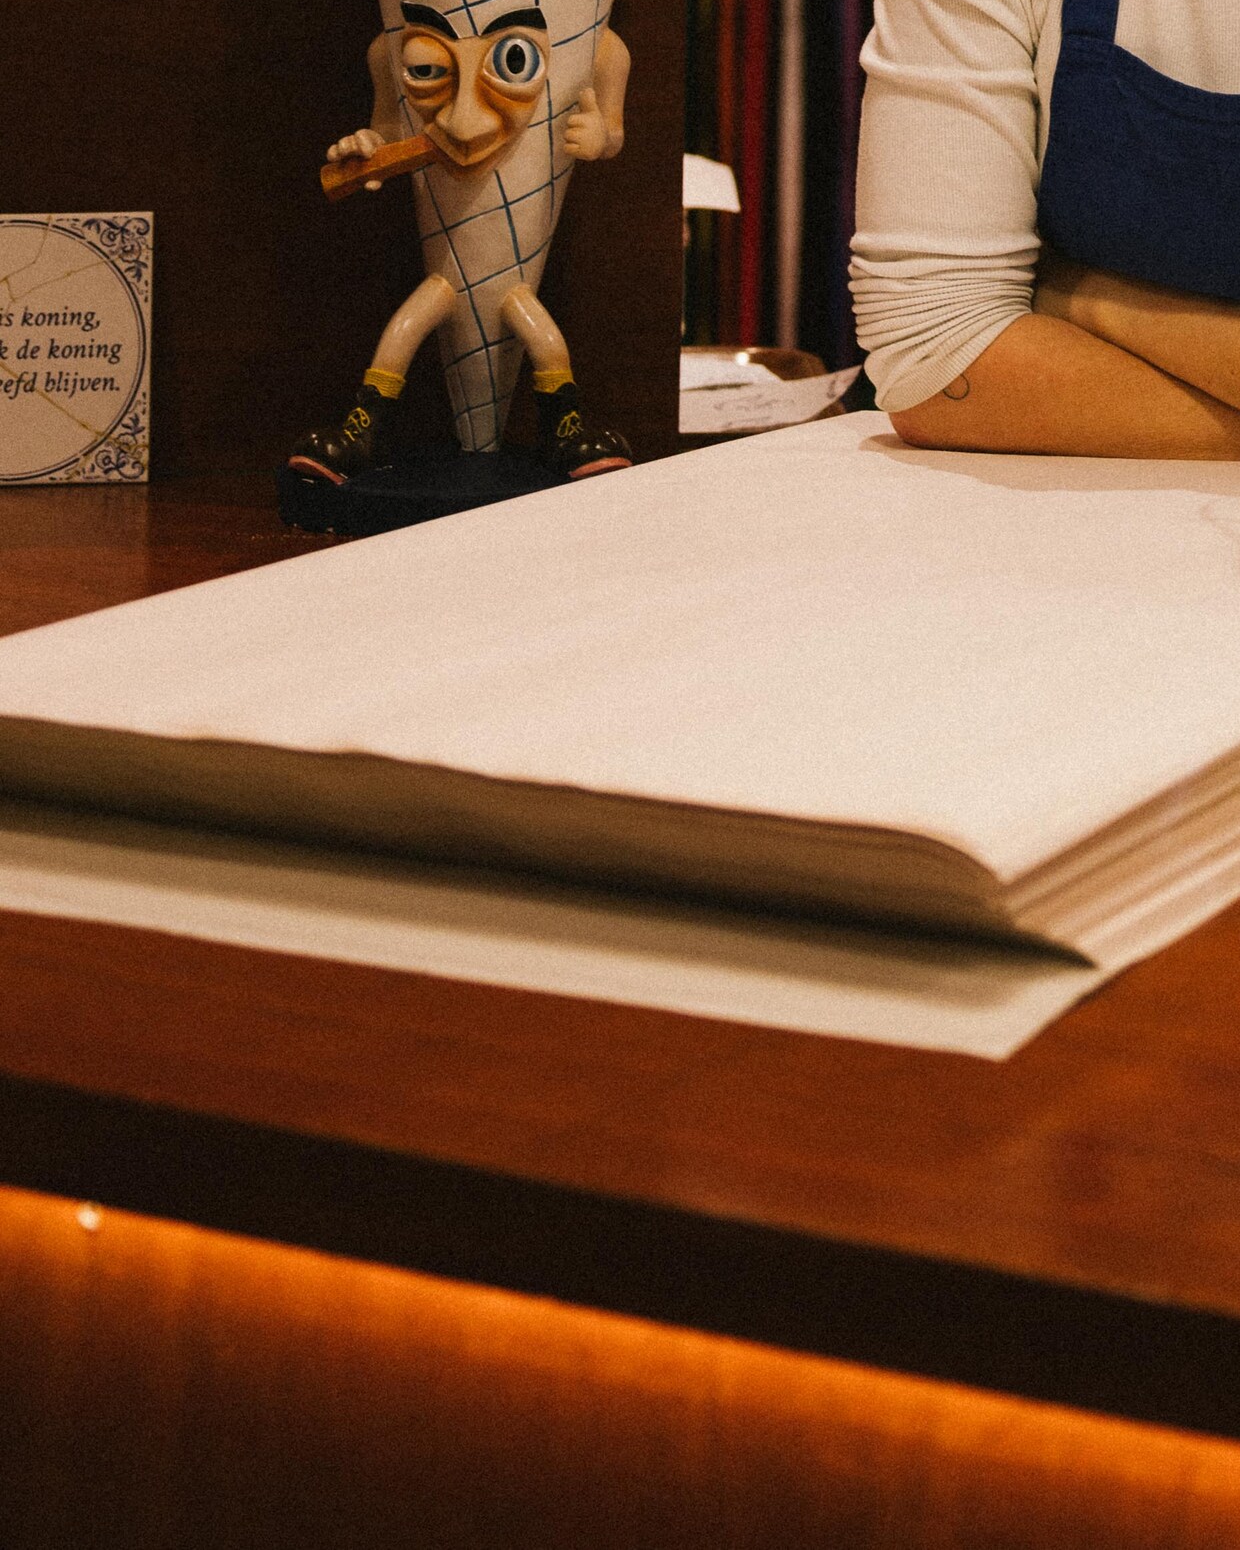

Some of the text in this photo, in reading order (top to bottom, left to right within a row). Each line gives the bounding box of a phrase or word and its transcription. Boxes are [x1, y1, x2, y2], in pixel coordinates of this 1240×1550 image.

[21, 306, 101, 332] koning,
[16, 339, 42, 360] de
[47, 338, 123, 364] koning
[44, 371, 120, 398] blijven.
